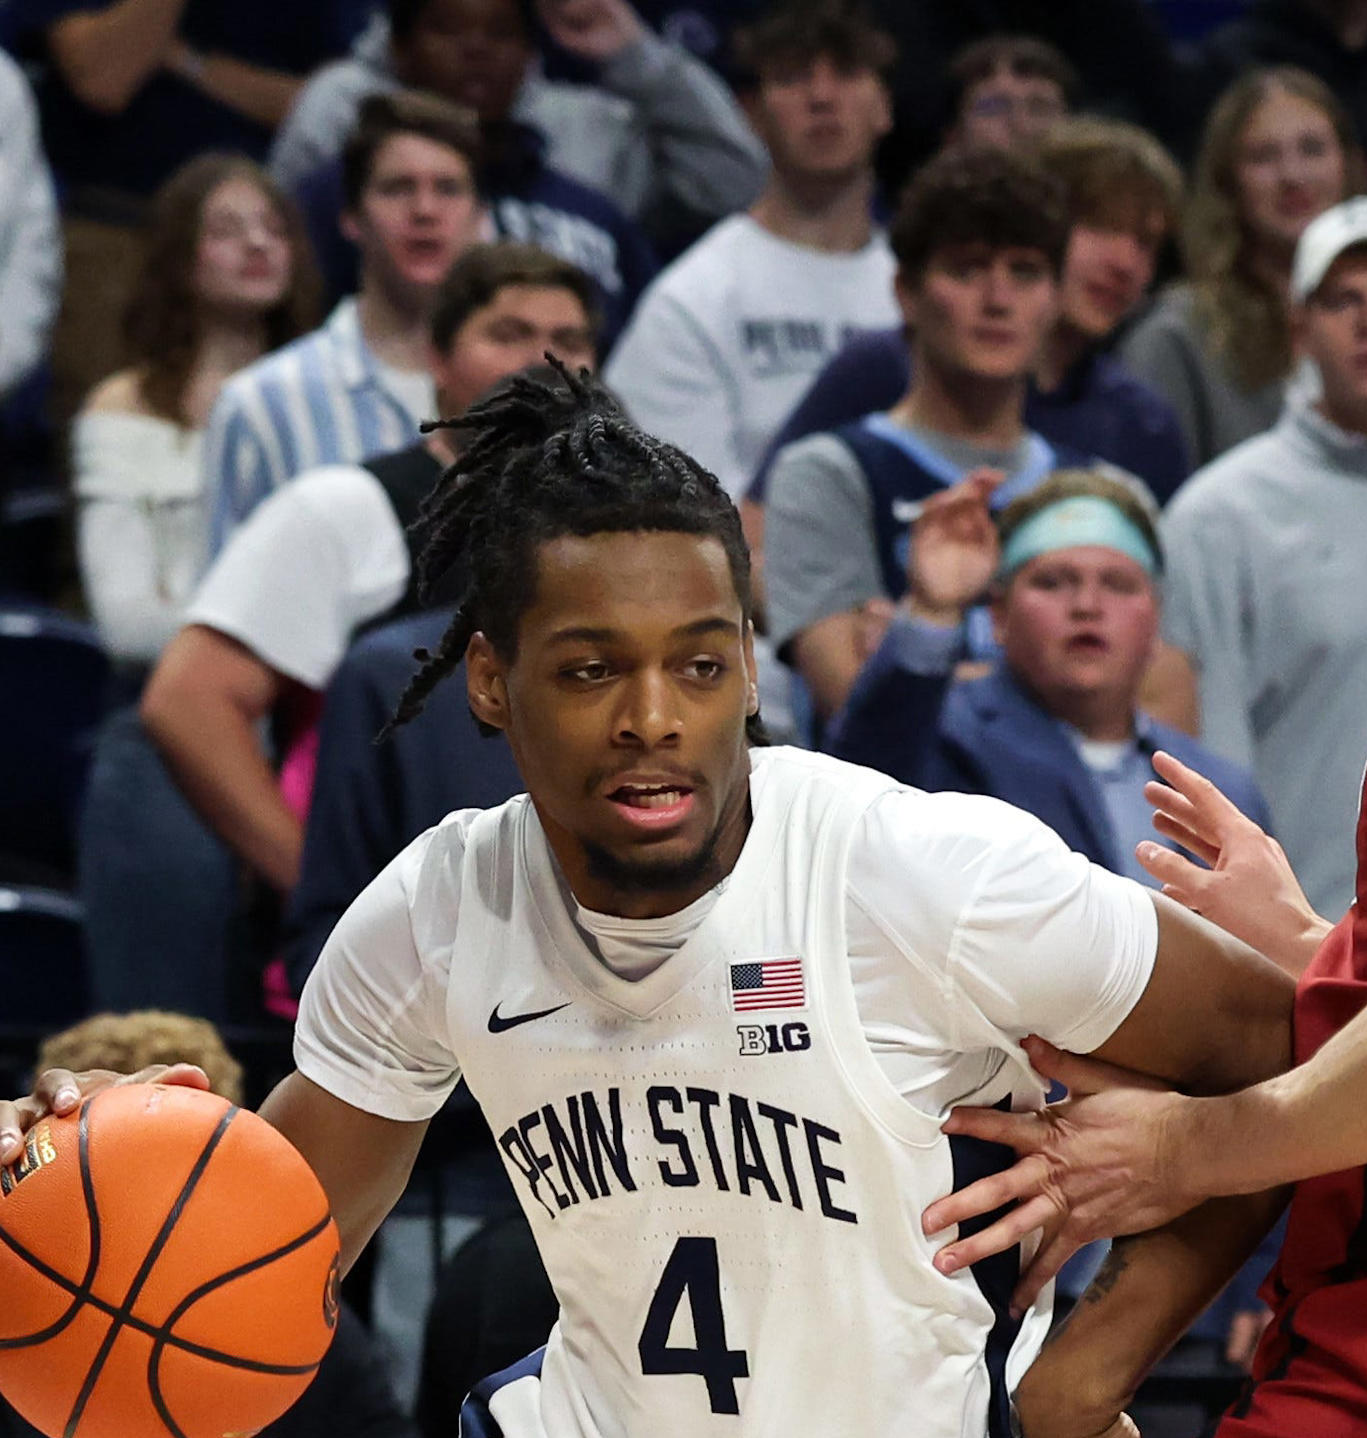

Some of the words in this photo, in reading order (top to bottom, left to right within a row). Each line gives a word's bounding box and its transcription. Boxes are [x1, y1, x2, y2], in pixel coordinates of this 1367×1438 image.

[498, 1086, 638, 1220] PENN
[645, 1085, 859, 1225] STATE
[637, 1236, 751, 1416] 4
